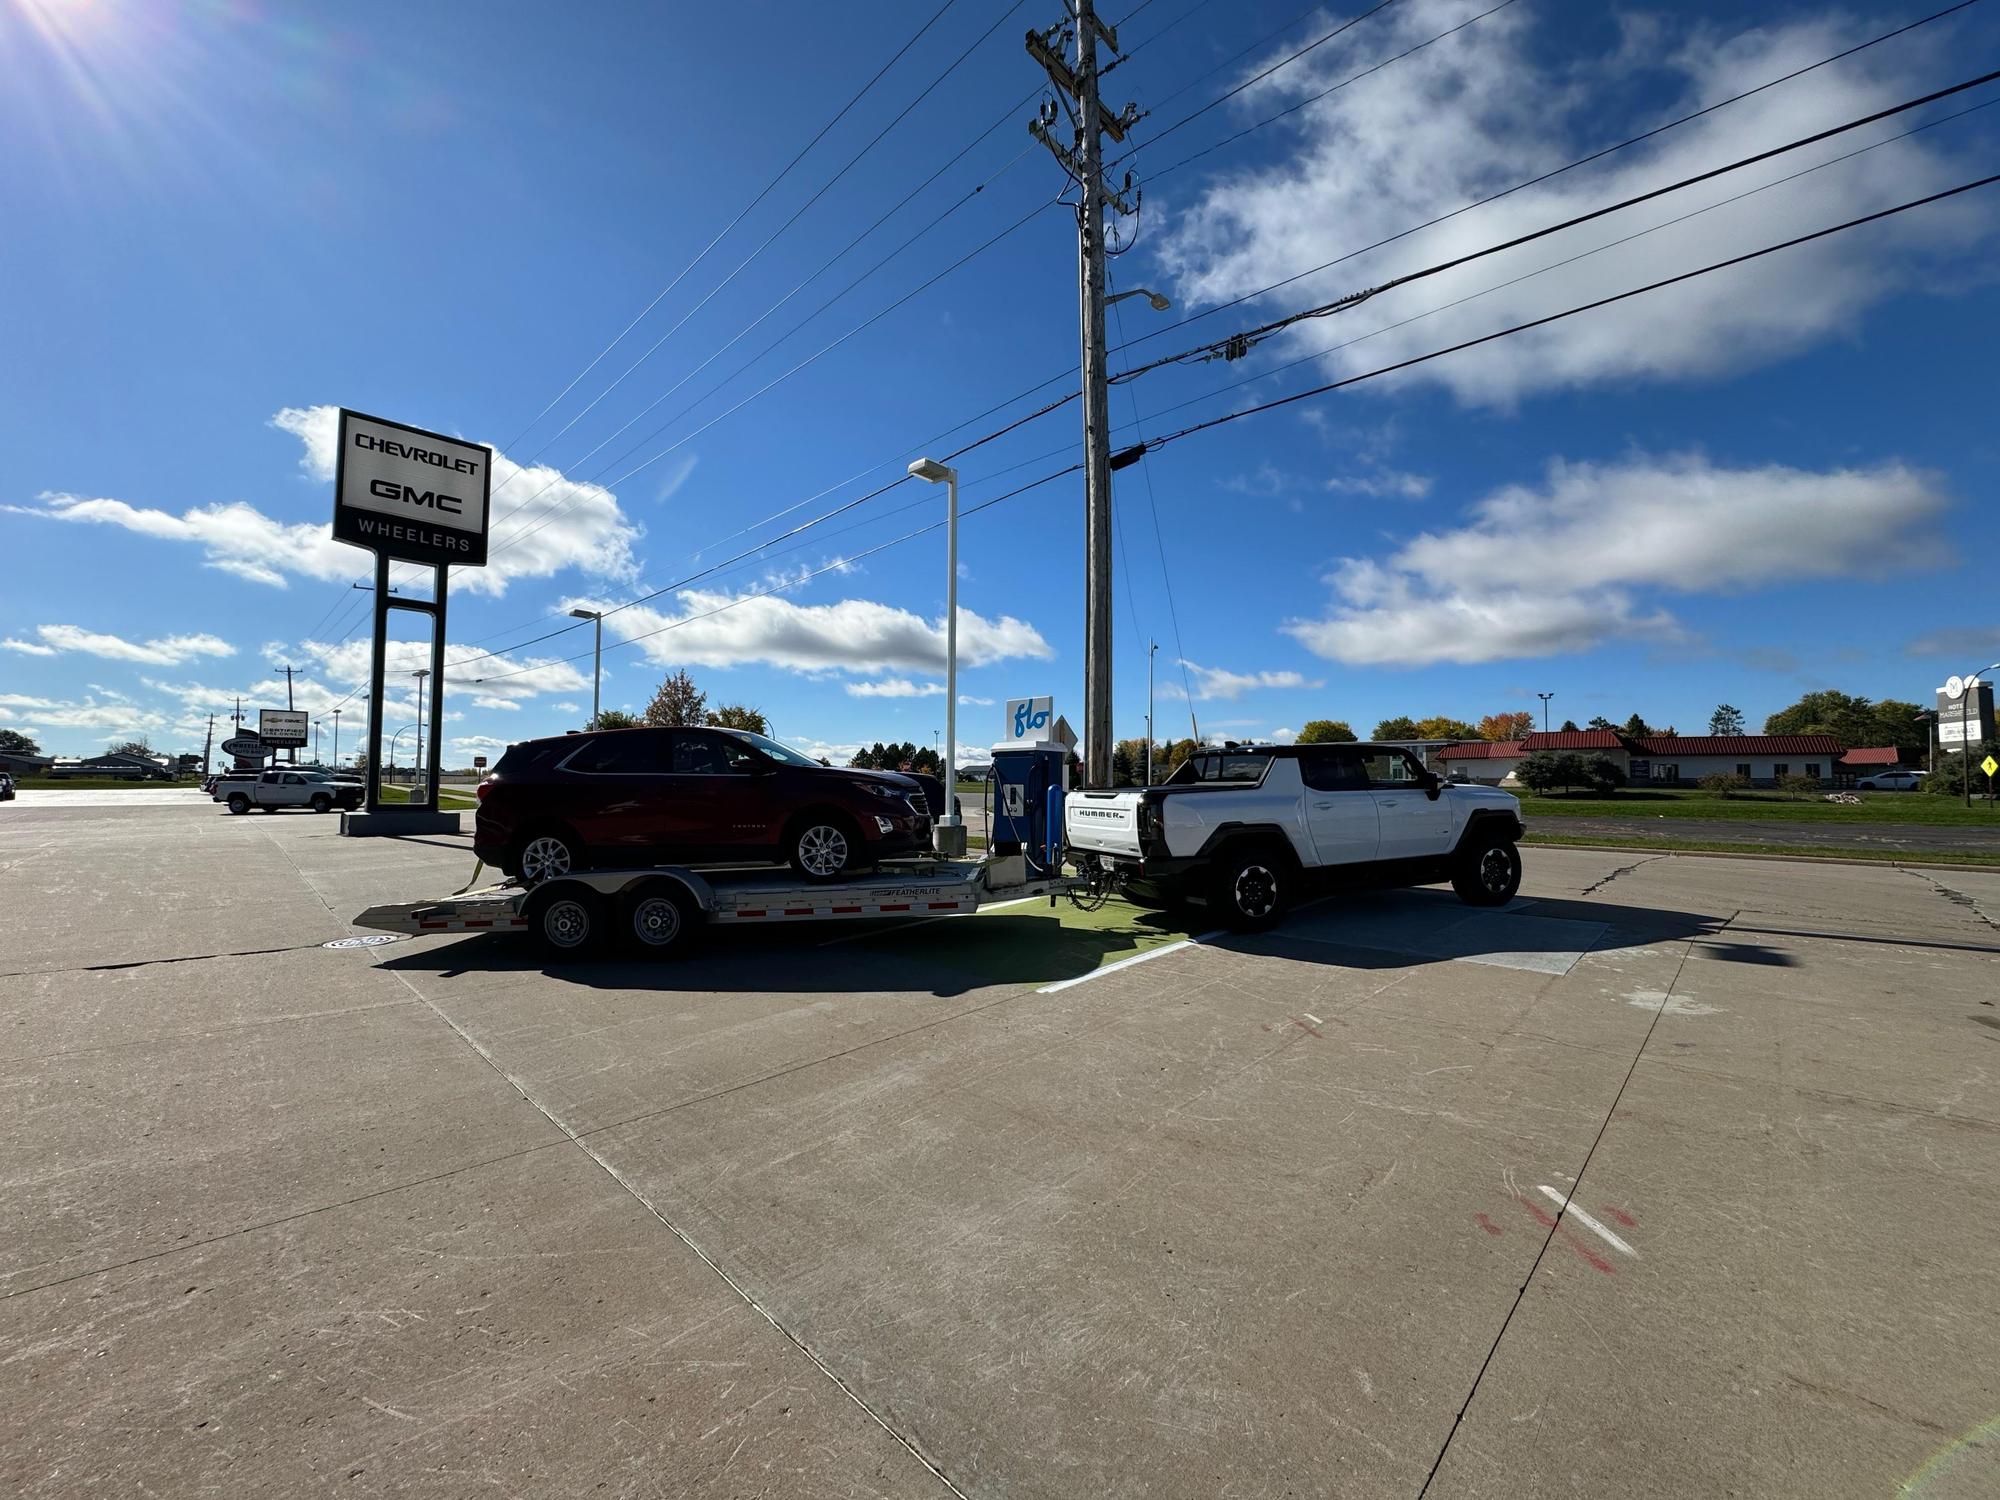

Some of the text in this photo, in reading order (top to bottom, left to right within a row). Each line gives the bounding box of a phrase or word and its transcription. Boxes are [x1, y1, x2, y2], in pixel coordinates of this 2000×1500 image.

[355, 433, 478, 475] CHEVROLET
[370, 479, 462, 514] GMC
[358, 518, 470, 552] WHEELERS
[1014, 698, 1049, 738] flo
[1079, 810, 1119, 818] HUMMER
[891, 888, 941, 896] FEATHERLITE
